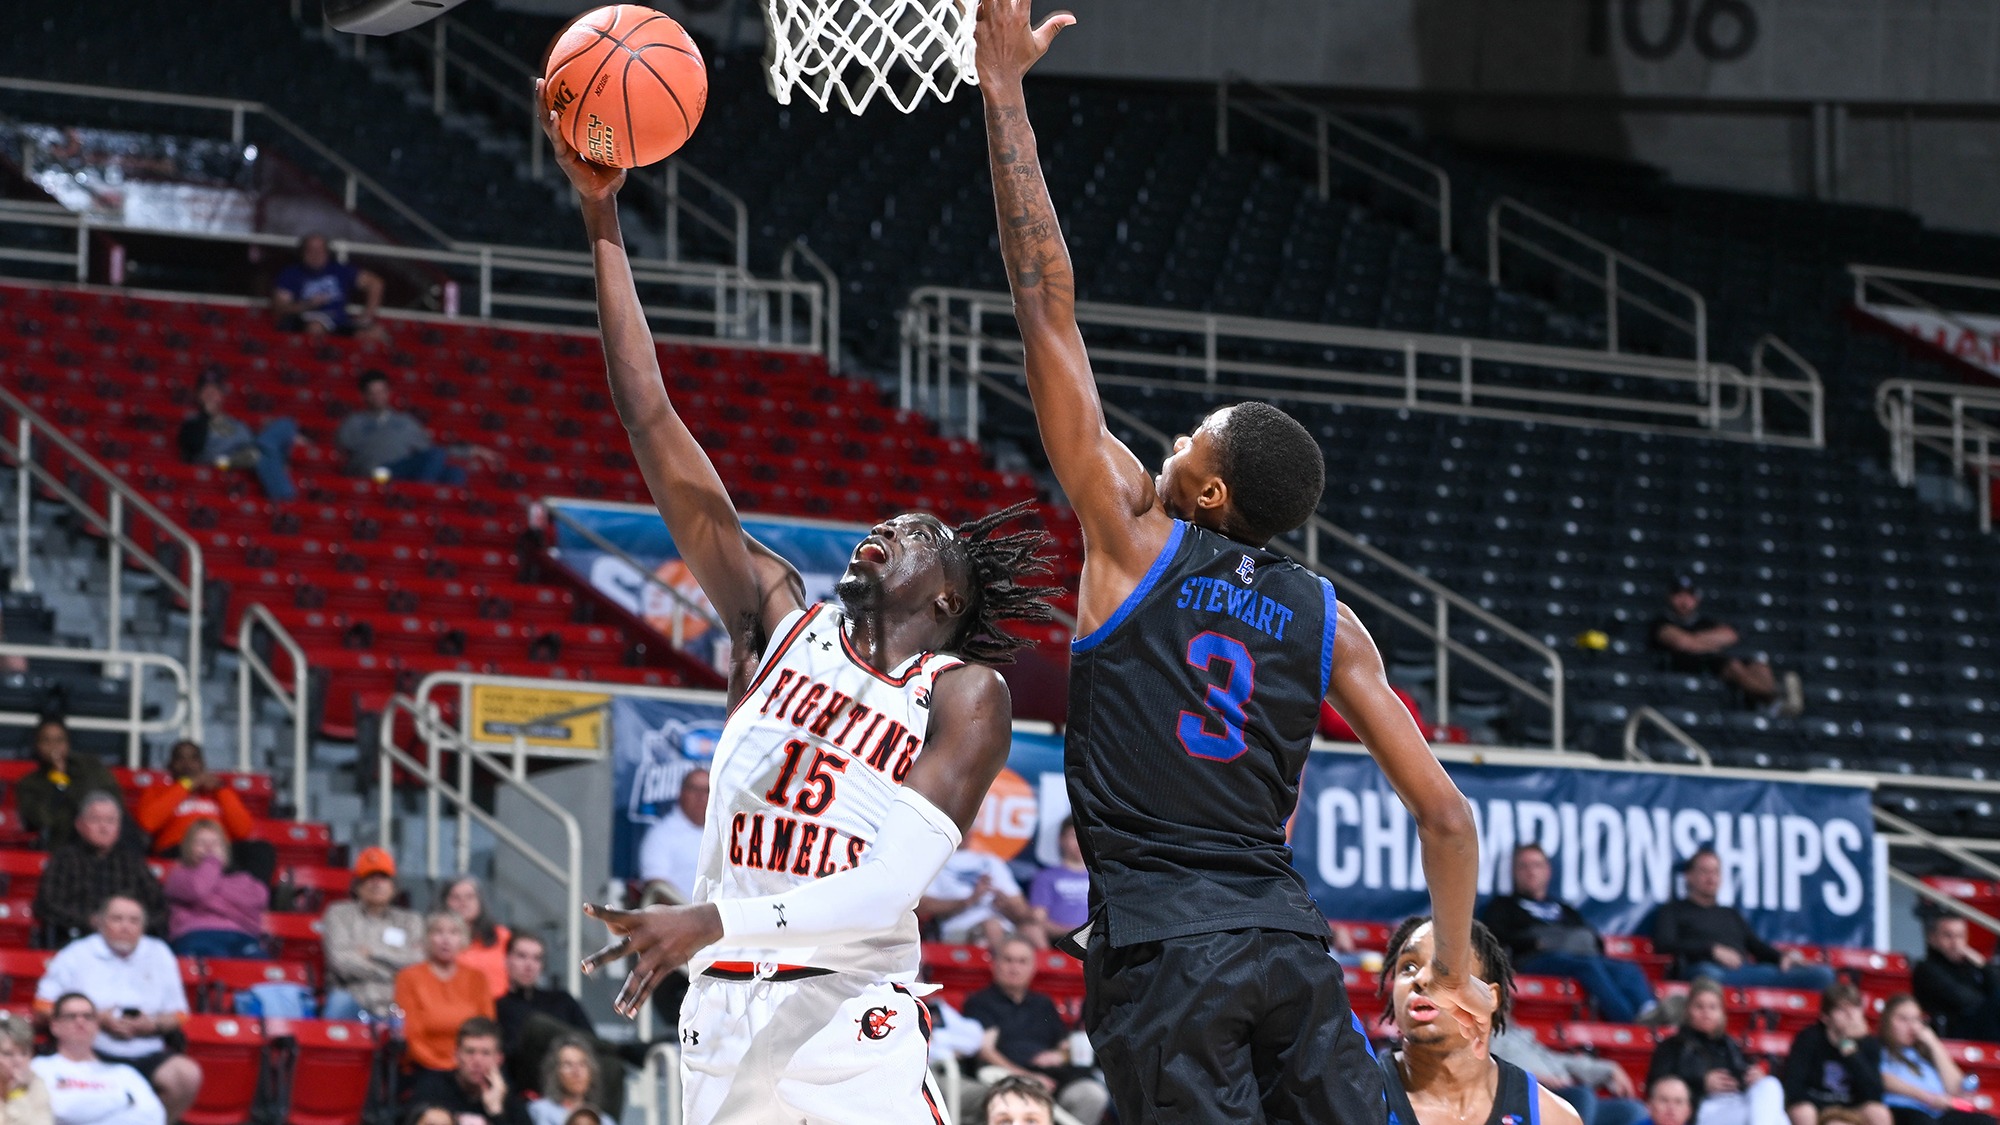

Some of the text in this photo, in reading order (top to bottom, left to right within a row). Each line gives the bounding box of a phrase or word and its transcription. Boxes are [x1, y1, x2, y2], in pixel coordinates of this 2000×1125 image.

[1176, 575, 1294, 642] STEWART
[760, 667, 922, 785] FIGHTING
[1176, 630, 1256, 764] 3
[765, 739, 850, 817] 15
[974, 793, 1038, 840] IG
[729, 811, 866, 879] CAMELS
[1316, 786, 1865, 917] CHMPIONSHIPS
